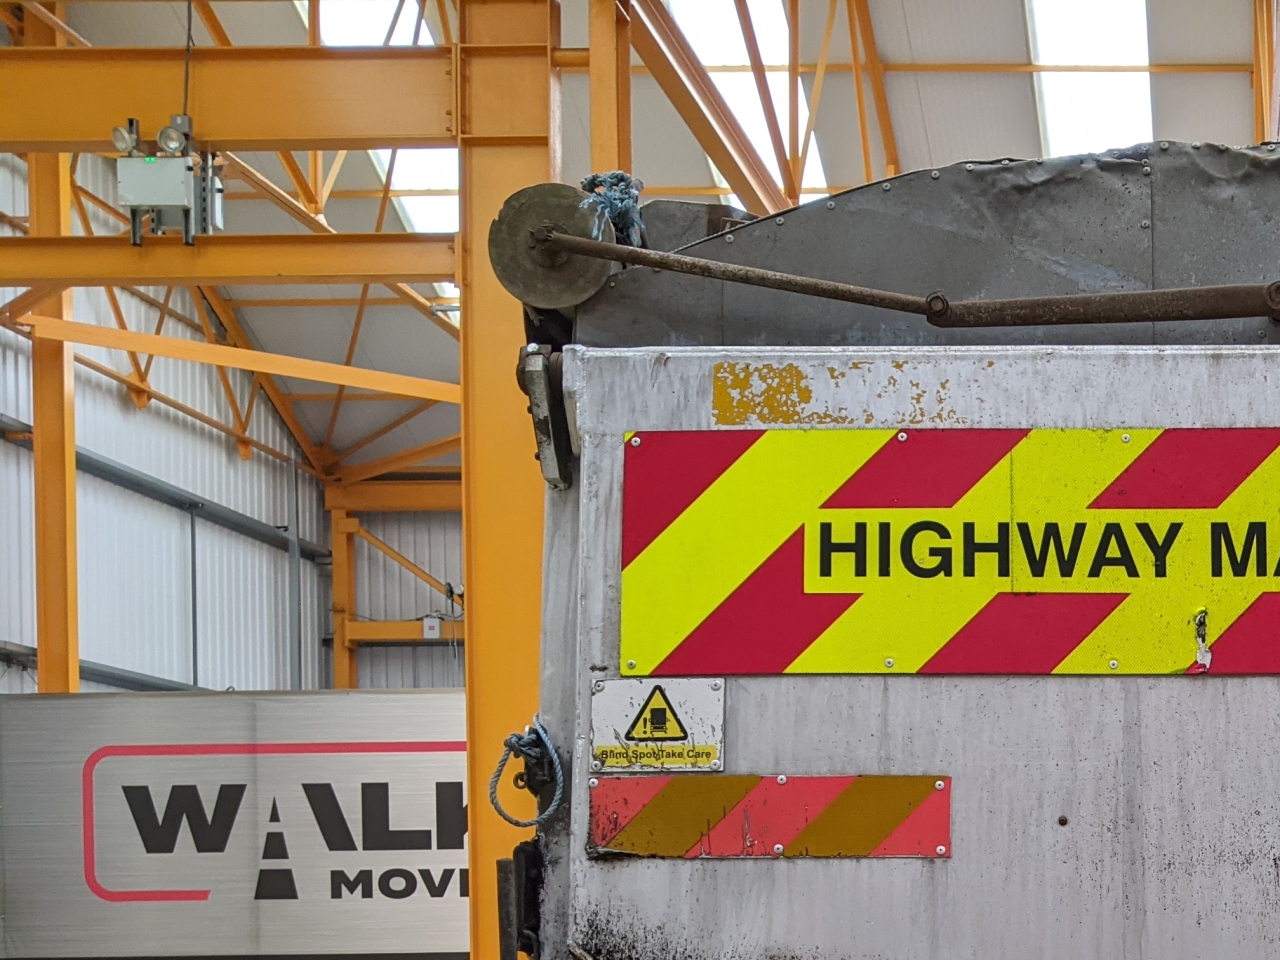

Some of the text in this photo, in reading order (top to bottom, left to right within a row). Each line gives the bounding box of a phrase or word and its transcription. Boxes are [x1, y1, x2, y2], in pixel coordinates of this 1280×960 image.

[818, 520, 1184, 578] HIGHWAY
[601, 750, 628, 759] Blind
[659, 750, 684, 759] Take
[687, 750, 712, 759] Care
[330, 867, 470, 899] MOV
